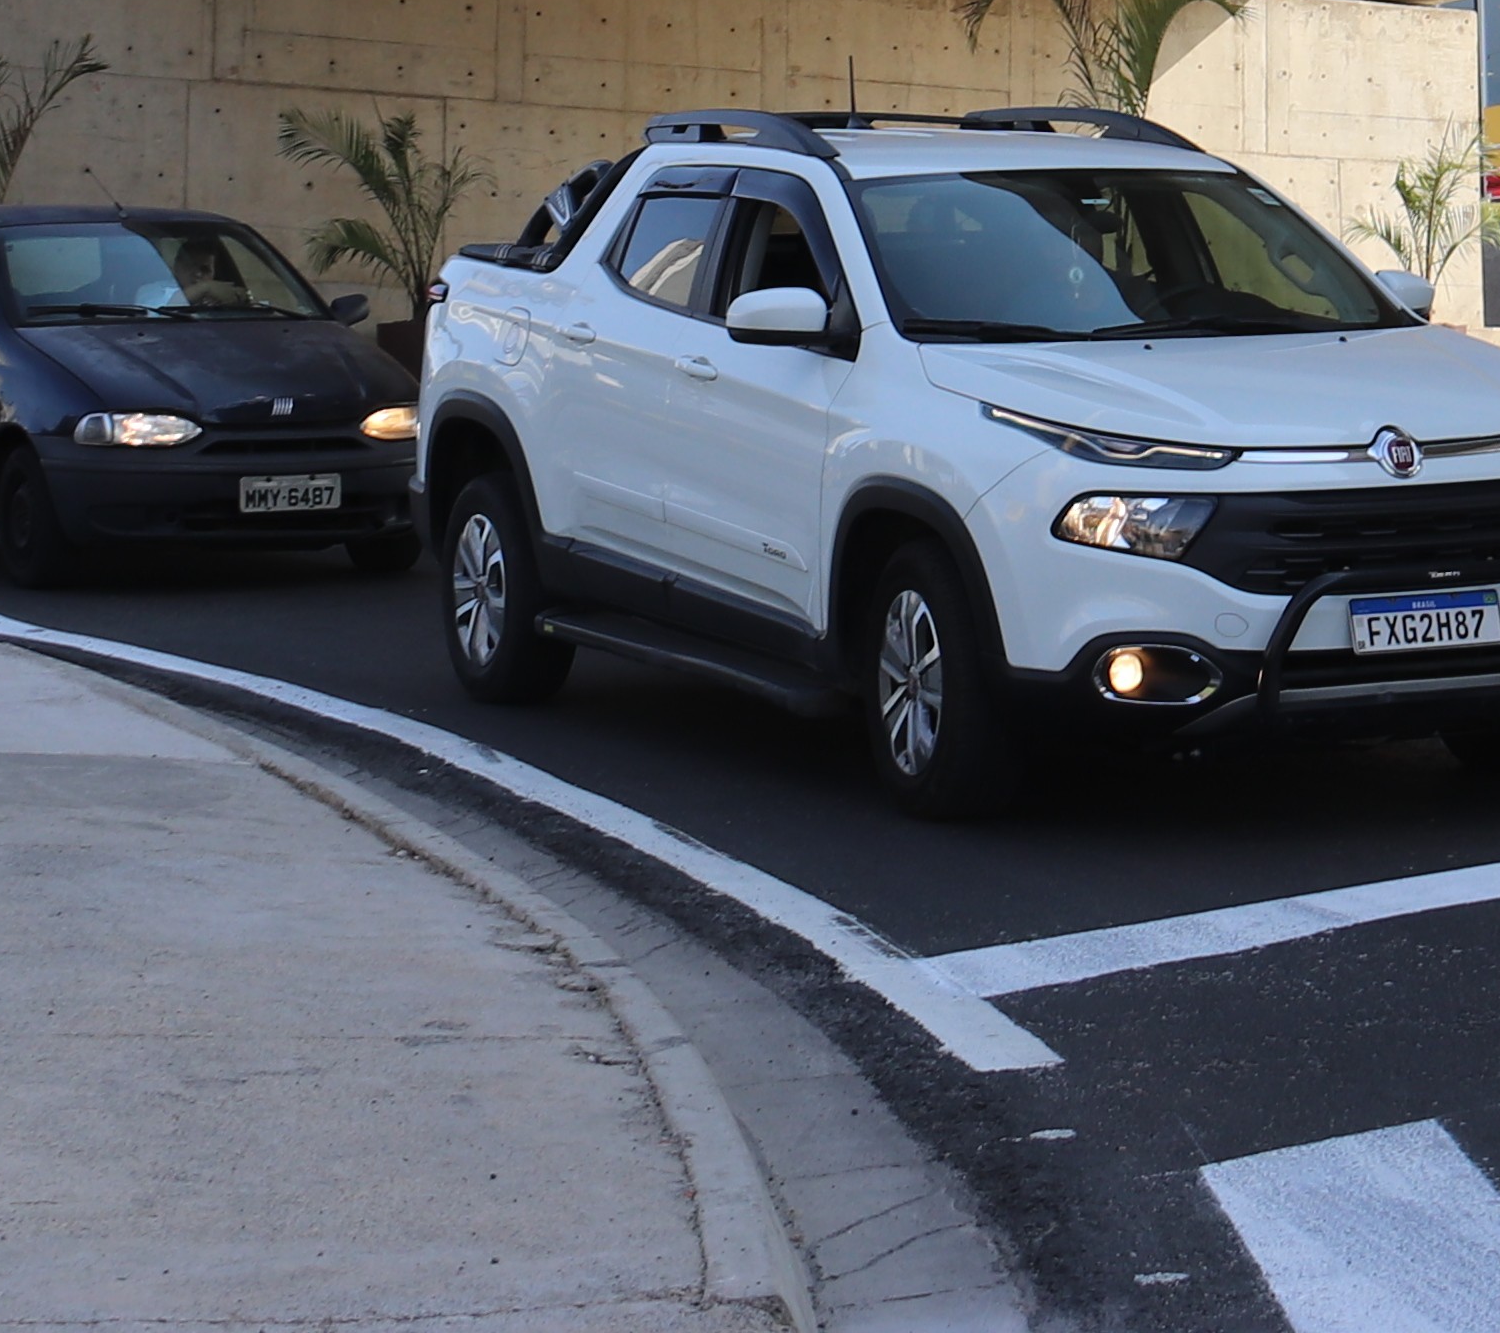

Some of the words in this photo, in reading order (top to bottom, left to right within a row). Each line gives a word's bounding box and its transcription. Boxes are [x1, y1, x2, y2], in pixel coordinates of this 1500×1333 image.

[1391, 445, 1412, 464] FIAT
[1412, 600, 1436, 609] BRASIL
[1366, 609, 1485, 647] FXG2H87
